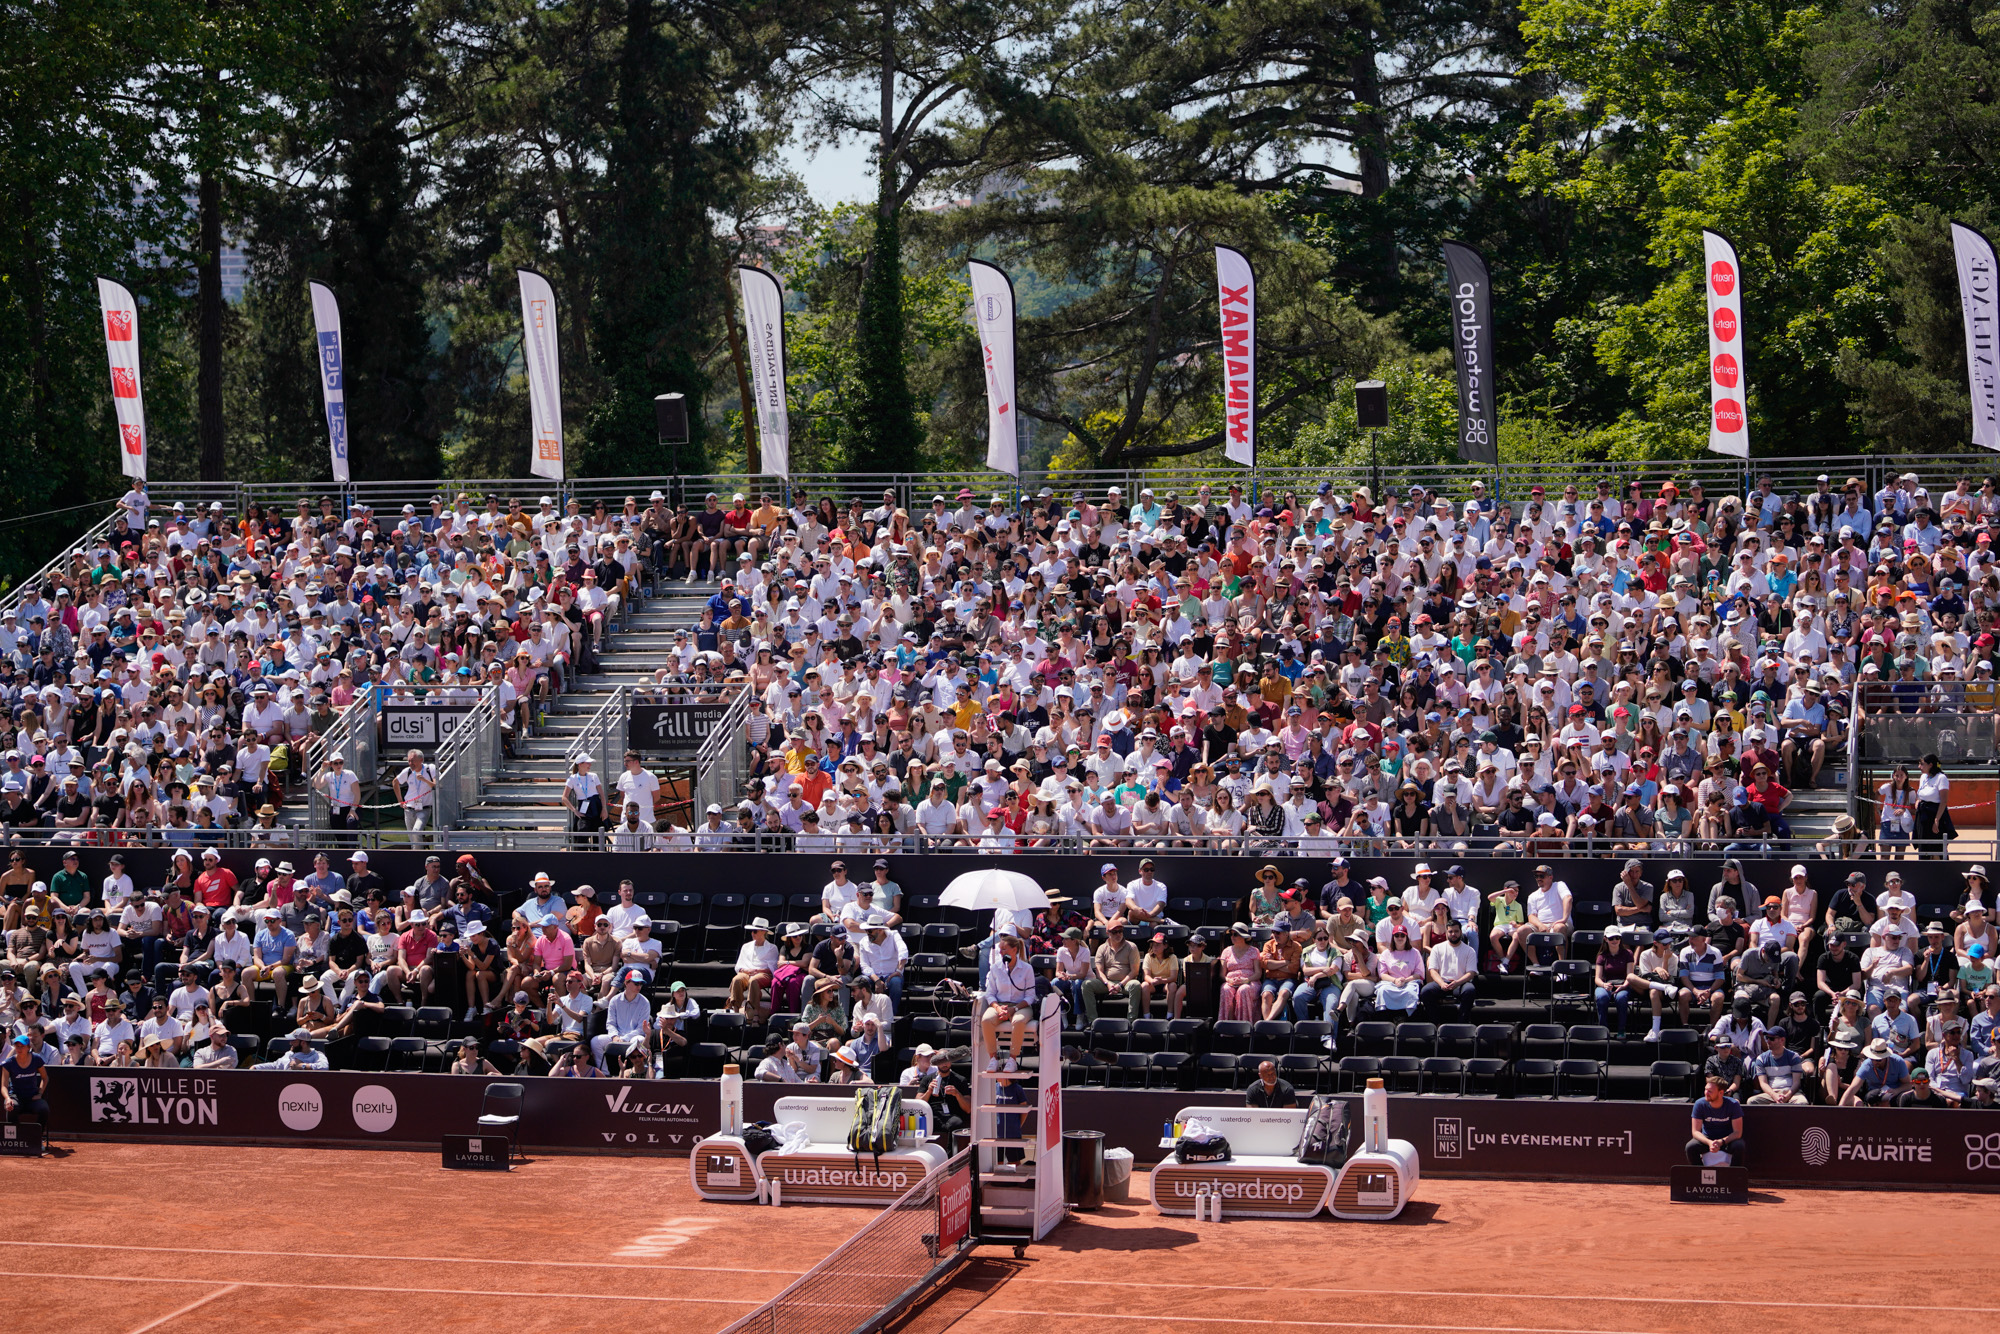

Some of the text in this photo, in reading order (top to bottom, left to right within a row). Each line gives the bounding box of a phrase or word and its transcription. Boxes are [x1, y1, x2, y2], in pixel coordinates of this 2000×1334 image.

[694, 710, 722, 719] media
[391, 716, 424, 733] dlsi
[653, 712, 691, 737] fill
[1838, 773, 1844, 782] F
[140, 1078, 217, 1095] VILLE DE
[605, 1085, 695, 1115] VULCAIN
[142, 1097, 218, 1125] LYON
[282, 1101, 319, 1112] nexity
[355, 1102, 393, 1113] nexity
[779, 1103, 809, 1112] waterdrop
[816, 1105, 847, 1113] waterdrop
[1220, 1115, 1252, 1124] waterdrop
[1259, 1117, 1292, 1125] waterdrop
[1438, 1123, 1457, 1135] TEN
[601, 1132, 704, 1144] VOLVO
[1501, 1132, 1593, 1147] ÉVÉNEMENT
[1439, 1141, 1456, 1152] NIS
[455, 1154, 496, 1162] LAVOREL
[1186, 1153, 1225, 1161] HEAD
[1837, 1144, 1932, 1162] FAURITE
[784, 1165, 908, 1191] waterdrop
[1174, 1177, 1303, 1205] waterdrop
[1686, 1186, 1732, 1194] LAVOREL
[941, 1181, 971, 1218] Emirates
[946, 1206, 968, 1236] FLY BETTER
